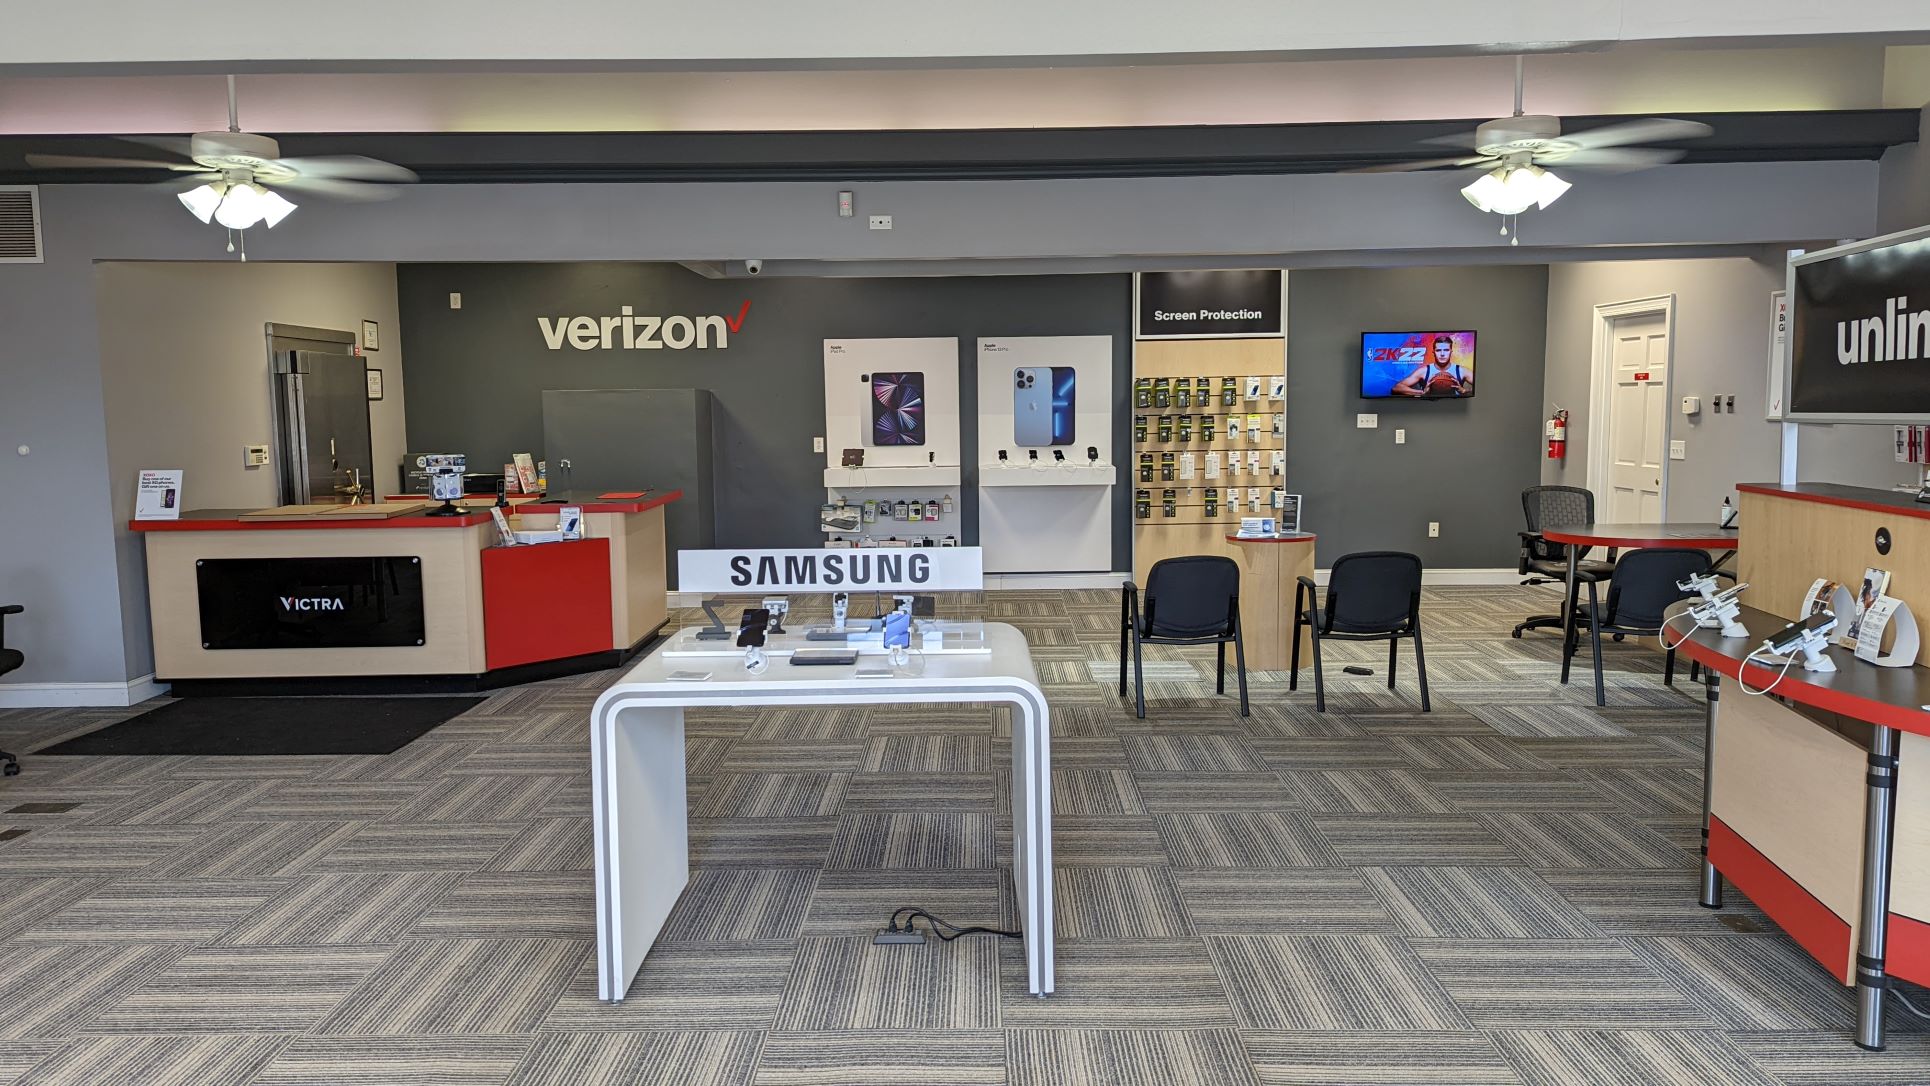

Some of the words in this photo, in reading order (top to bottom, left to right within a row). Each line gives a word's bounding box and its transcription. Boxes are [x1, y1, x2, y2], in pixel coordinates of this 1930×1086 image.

[1154, 310, 1197, 321] Screen
[1200, 308, 1262, 320] Protection
[537, 305, 728, 350] verizon
[1373, 347, 1427, 362] 2K22
[730, 553, 930, 587] SAMSUNG
[280, 596, 344, 611] VICTRA
